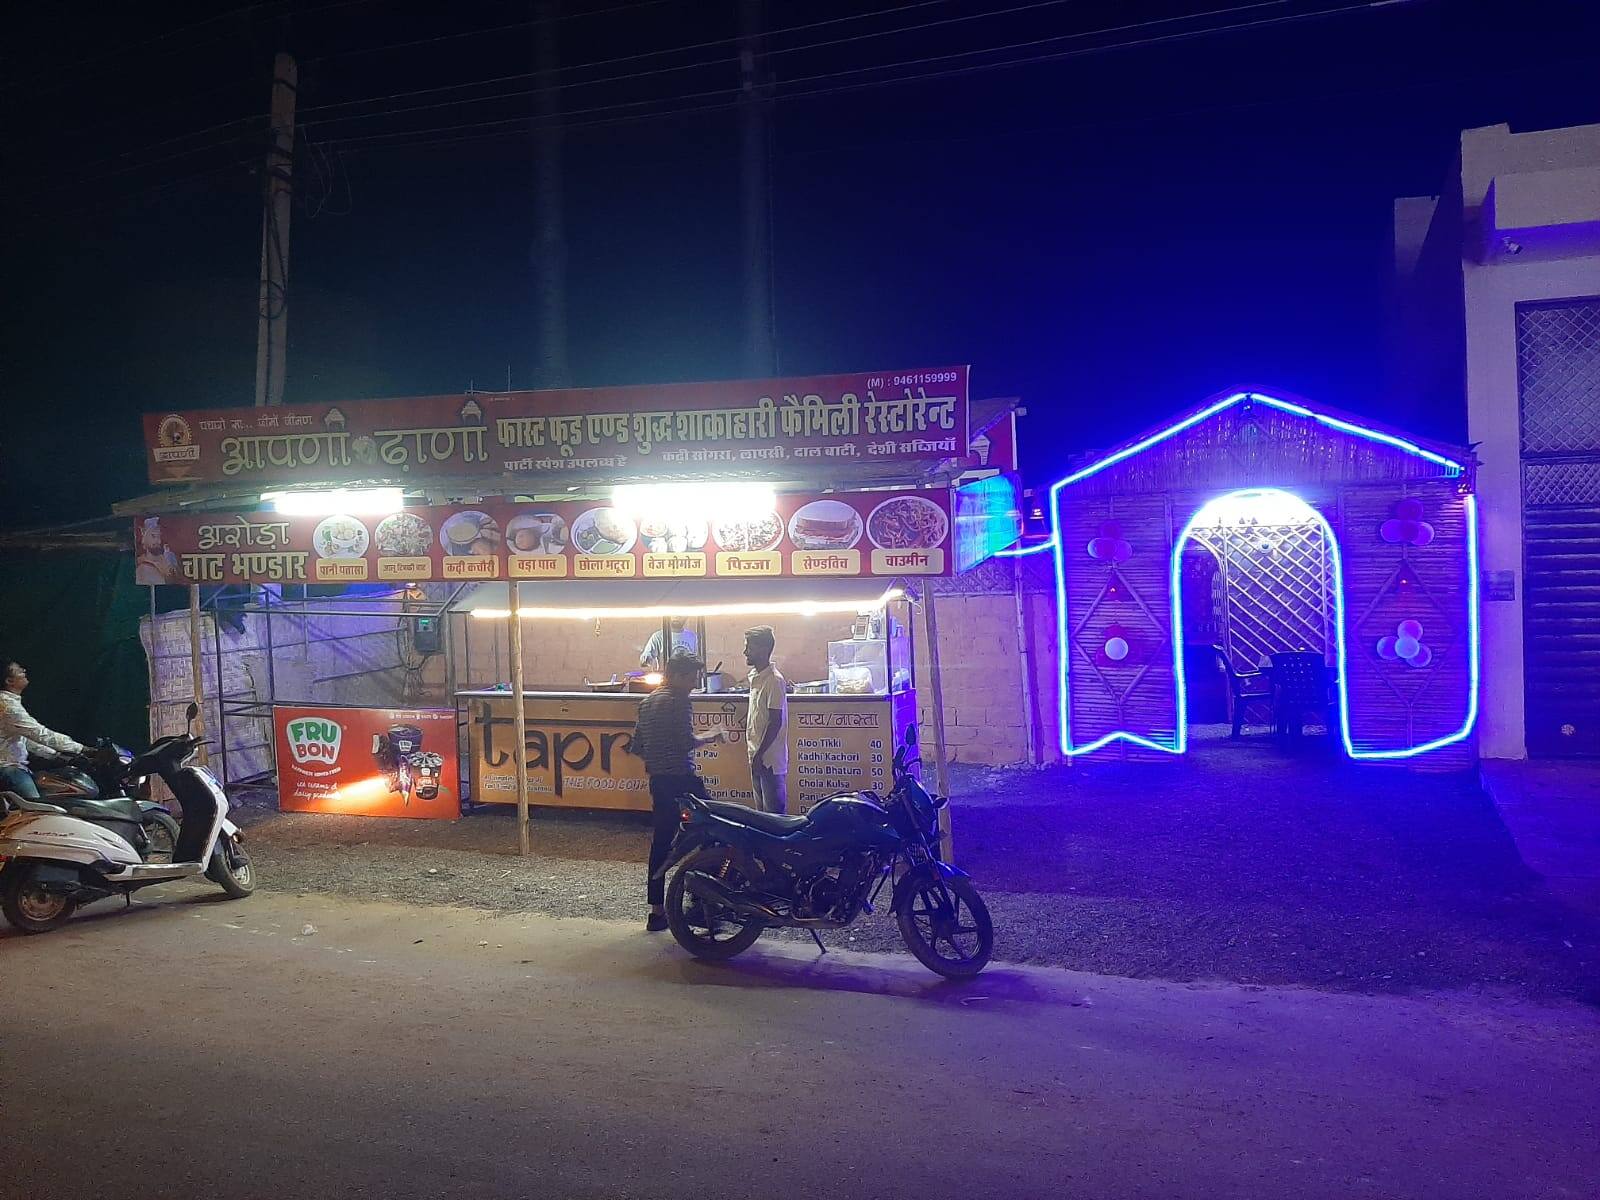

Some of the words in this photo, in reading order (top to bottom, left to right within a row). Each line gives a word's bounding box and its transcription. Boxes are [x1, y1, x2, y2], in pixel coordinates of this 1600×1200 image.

[867, 378, 884, 389] (M)
[893, 372, 957, 386] 9461159999
[497, 417, 546, 448] फास्ट
[549, 415, 584, 457] फूड
[586, 413, 629, 444] एण्ड
[633, 411, 674, 455] शुद्ध
[676, 398, 777, 441] शाकाहारी
[780, 394, 861, 438] फैमिली
[864, 386, 957, 434] रेस्टोरेन्ट
[793, 446, 822, 457] दाल
[866, 441, 897, 455] देशी
[198, 515, 291, 549] अरोड़ा
[181, 553, 227, 580] चाट
[231, 551, 309, 580] भण्डार
[538, 559, 557, 569] पाव
[648, 557, 665, 569] वेज
[667, 556, 702, 569] मोमोज
[727, 559, 771, 571] पिज्जा
[886, 554, 928, 567] चाउमीन
[319, 563, 338, 575] पानी
[290, 722, 337, 743] FRU
[475, 702, 637, 798] tapr
[797, 739, 818, 748] Aloo
[820, 739, 841, 748] Tikki
[870, 740, 882, 749] 40
[296, 743, 335, 760] BON
[797, 752, 823, 761] Kadhi
[825, 752, 859, 761] Kachori
[871, 754, 882, 762] 30
[798, 766, 823, 774] Chola
[826, 766, 862, 775] Bhatura
[871, 768, 883, 776] 50
[586, 778, 614, 789] FOOD
[703, 776, 719, 785] haji
[798, 780, 823, 788] Chola
[872, 782, 884, 790] 30
